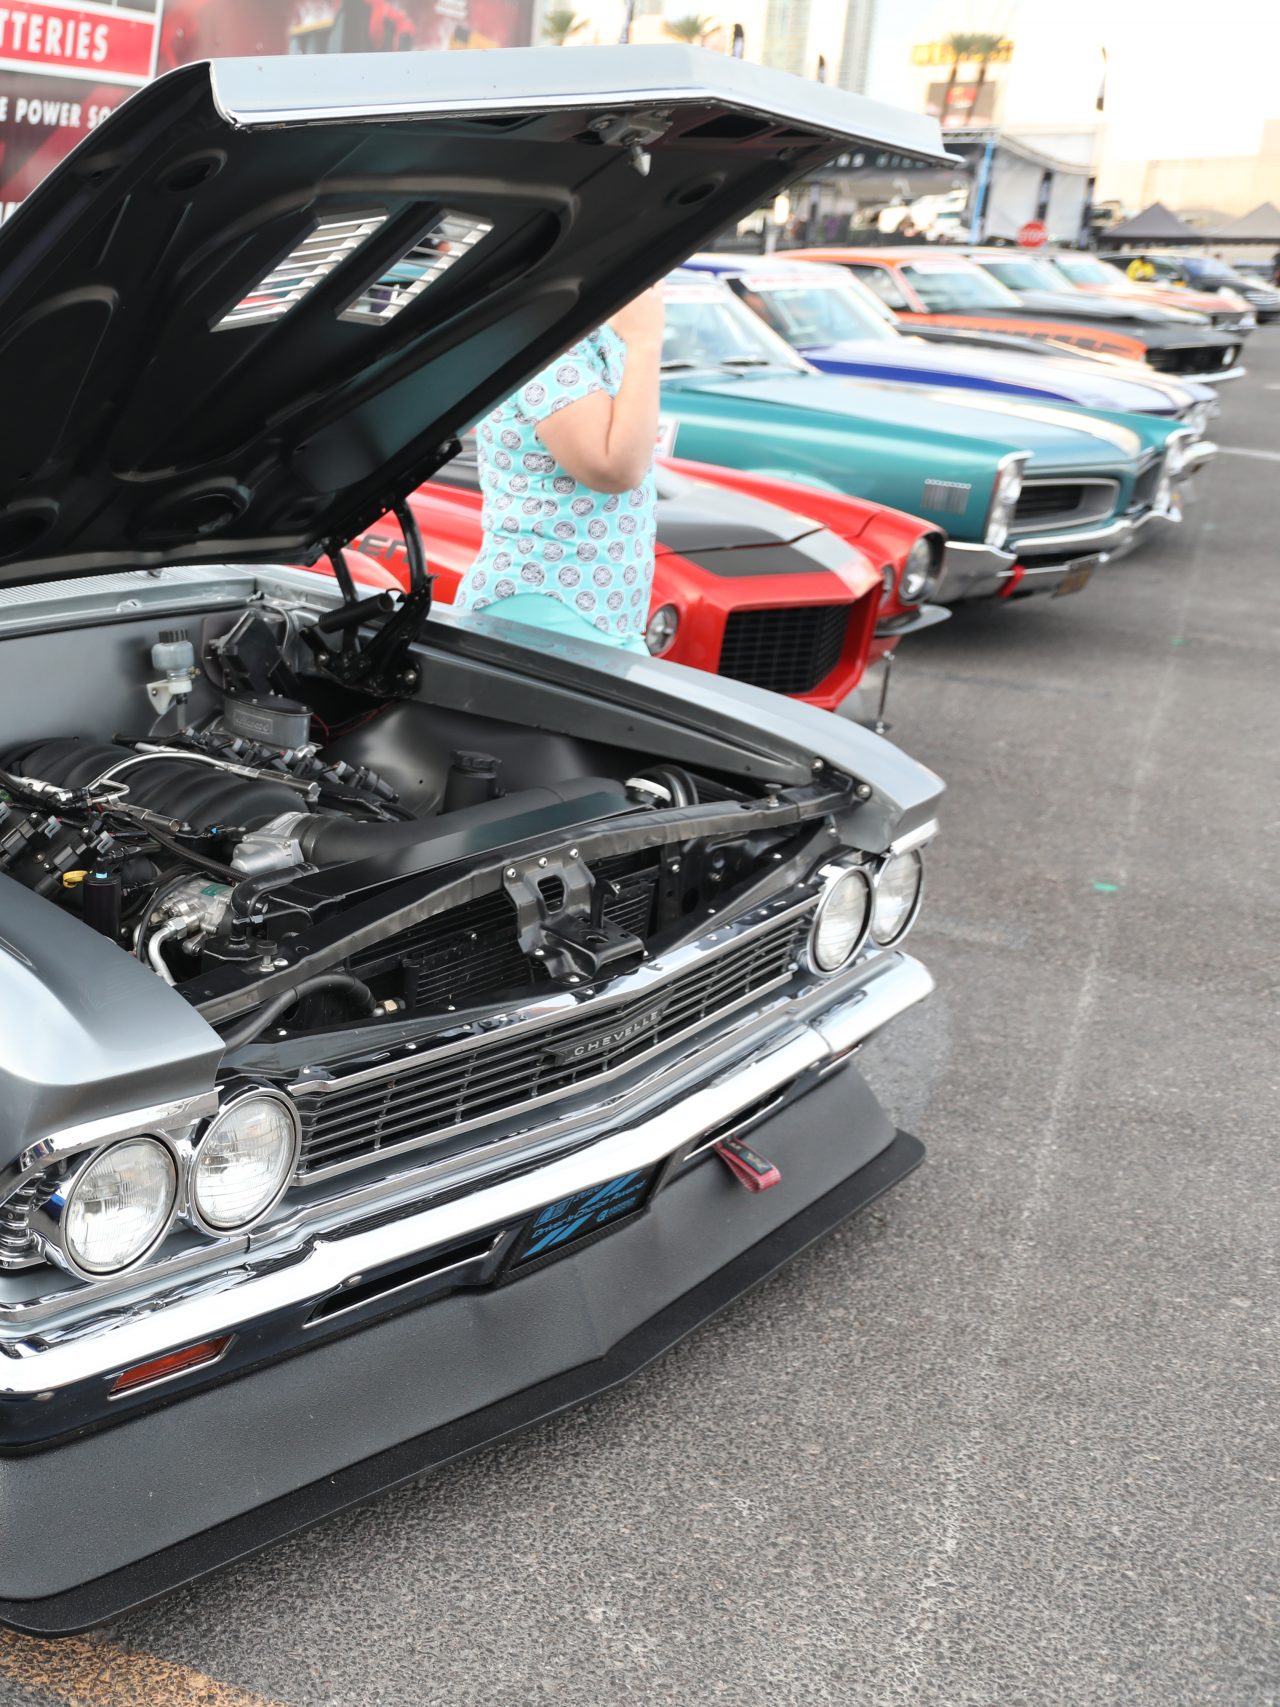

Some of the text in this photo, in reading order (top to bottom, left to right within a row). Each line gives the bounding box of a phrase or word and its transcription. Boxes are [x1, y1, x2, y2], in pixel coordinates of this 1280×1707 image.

[15, 98, 81, 128] POWER
[87, 104, 113, 129] SO
[574, 1010, 659, 1056] CHEVELLE
